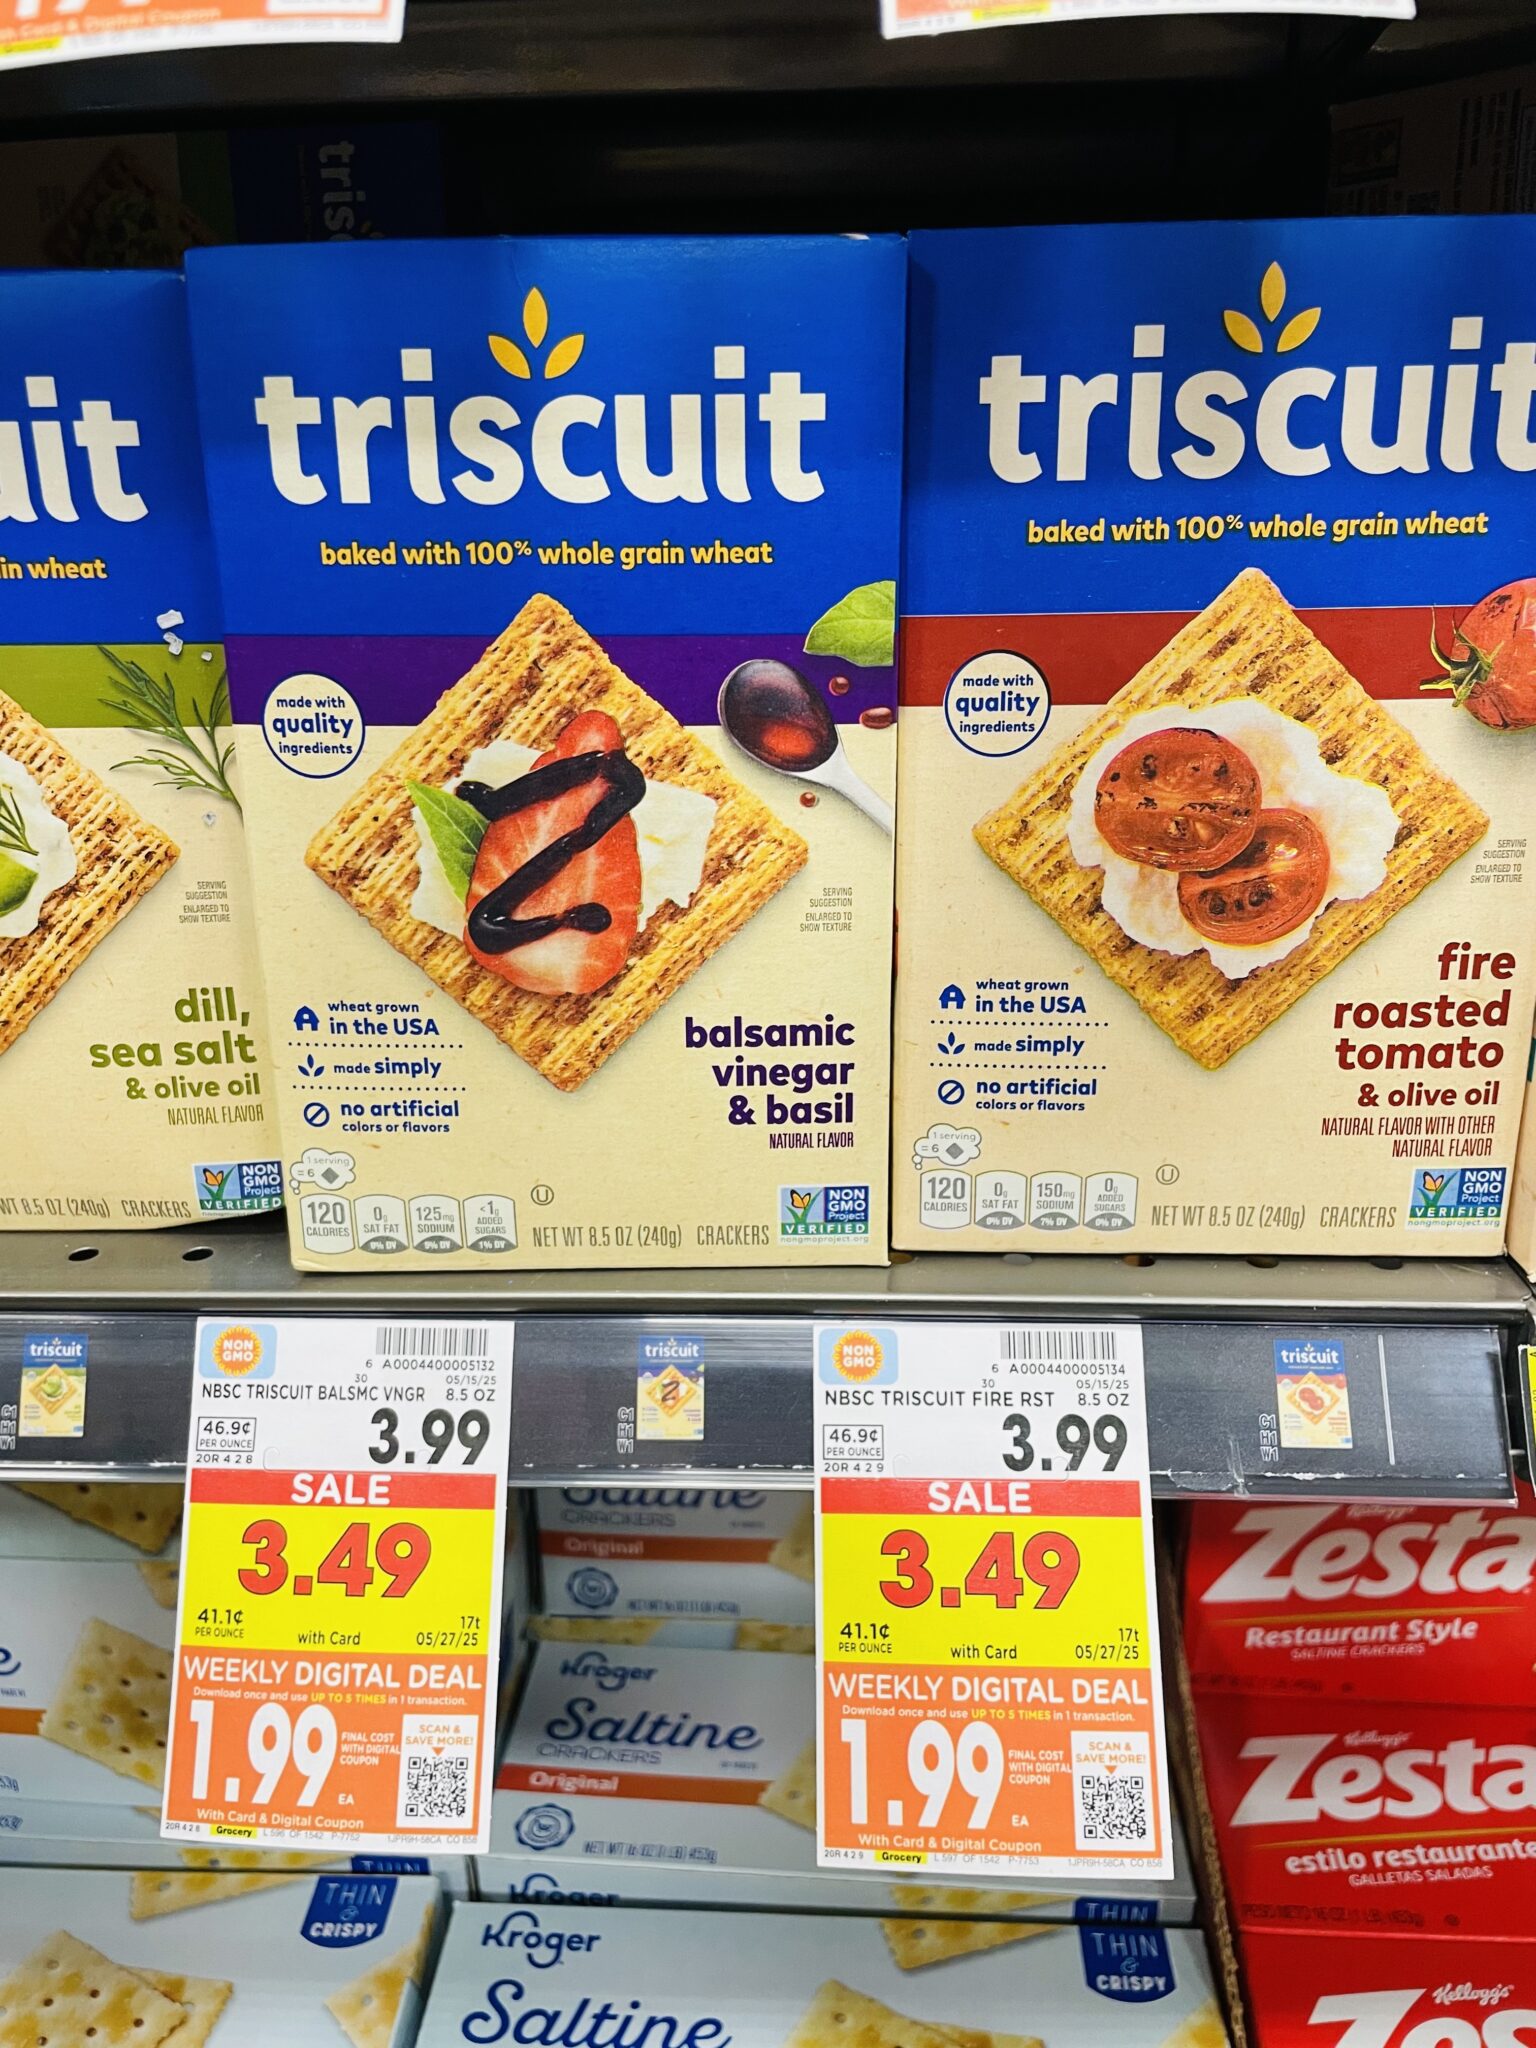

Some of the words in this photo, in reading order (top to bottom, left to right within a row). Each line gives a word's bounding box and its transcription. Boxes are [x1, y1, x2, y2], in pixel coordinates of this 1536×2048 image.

[255, 346, 826, 505] triscuit
[1027, 520, 1105, 543] baked
[1111, 518, 1169, 541] with
[1177, 514, 1243, 540] 100%
[1249, 514, 1326, 538] whole
[1332, 513, 1398, 541] grain
[1405, 512, 1489, 535] wheat
[320, 540, 396, 566] baked
[402, 541, 460, 565] with
[466, 540, 531, 565] 100%
[538, 541, 614, 565] whole
[621, 542, 684, 570] grain
[691, 540, 772, 564] wheat
[27, 557, 108, 579] wheat
[963, 675, 999, 687] made
[1003, 674, 1033, 687] with
[276, 696, 311, 709] made
[316, 696, 345, 709] with
[955, 691, 1040, 714] quality
[272, 713, 353, 738] quality
[959, 720, 1035, 735] ingredients
[278, 741, 353, 757] ingredients
[809, 898, 852, 907] SUGGESTION
[822, 888, 852, 897] SERVING
[1438, 942, 1516, 980] fire
[174, 987, 251, 1027] dill,
[328, 1001, 372, 1012] wheat
[377, 1003, 419, 1014] grown
[1334, 989, 1511, 1029] roasted
[330, 1018, 348, 1035] in
[353, 1018, 388, 1035] the
[394, 1019, 439, 1036] USA
[684, 1014, 855, 1048] balsamic
[89, 1043, 162, 1068] sea
[175, 1030, 258, 1066] salt
[1336, 1038, 1504, 1070] tomato
[333, 1063, 370, 1074] made
[375, 1057, 441, 1078] simply
[712, 1056, 854, 1093] vinegar
[126, 1078, 148, 1099] &
[155, 1076, 220, 1099] olive
[228, 1073, 261, 1096] oil
[1358, 1083, 1379, 1107] &
[1388, 1082, 1456, 1106] olive
[1465, 1081, 1499, 1106] oil
[340, 1102, 364, 1116] no
[370, 1100, 459, 1116] artificial
[728, 1095, 756, 1125] &
[767, 1092, 854, 1124] basil
[342, 1122, 381, 1132] colors
[386, 1123, 398, 1132] or
[403, 1122, 450, 1132] flavors
[1321, 1118, 1375, 1136] NATURAL
[1379, 1117, 1422, 1135] FLAVOR
[1426, 1117, 1454, 1134] WITH
[1458, 1116, 1495, 1134] OTHER
[769, 1133, 814, 1149] NATURAL
[817, 1132, 854, 1148] FLAVOR
[1392, 1139, 1444, 1157] NATURAL
[1449, 1138, 1492, 1157] FLAVOR
[1465, 1171, 1501, 1182] NON
[829, 1189, 865, 1200] NON
[1463, 1182, 1501, 1194] GMO
[24, 1199, 43, 1216] 8.5
[50, 1200, 66, 1216] OZ
[68, 1199, 111, 1219] (240g)
[121, 1200, 191, 1219] CRACKERS
[307, 1202, 345, 1224] 120
[828, 1200, 866, 1211] GMO
[1414, 1206, 1499, 1218] VERIFIED
[828, 1211, 865, 1222] Project
[306, 1226, 349, 1237] CALORIES
[417, 1224, 455, 1233] SODIUM
[533, 1227, 558, 1248] NET
[562, 1227, 583, 1247] WT
[589, 1226, 610, 1246] 8.5
[616, 1226, 632, 1246] OZ
[638, 1226, 682, 1249] (240g)
[697, 1225, 769, 1246] CRACKERS
[784, 1223, 866, 1234] VERIFIED
[29, 1342, 83, 1357] triscuit
[223, 1339, 253, 1350] NON
[645, 1342, 699, 1357] triscuit
[842, 1345, 874, 1356] NON
[223, 1351, 253, 1362] GMO
[843, 1356, 875, 1368] GMO
[1281, 1348, 1339, 1364] triscuit
[446, 1375, 497, 1385] 05/15/25
[202, 1384, 241, 1399] NBSC
[247, 1385, 313, 1400] TRISCUIT
[319, 1386, 378, 1401] BALSMC
[384, 1386, 424, 1401] VNGR
[446, 1389, 468, 1401] 8.5
[474, 1389, 496, 1402] OZ
[825, 1390, 874, 1406] NBSC
[881, 1390, 965, 1406] TRISCUIT
[973, 1392, 1013, 1407] FIRE
[1021, 1392, 1055, 1407] RST
[204, 1421, 251, 1435] 46.9¢
[368, 1407, 490, 1465] 3.99
[829, 1428, 878, 1443] 46.9¢
[1002, 1413, 1127, 1472] 3.99
[291, 1473, 392, 1505] SALE
[928, 1482, 1031, 1513] SALE
[563, 1537, 644, 1556] Original
[1200, 1504, 1536, 1604] Zesta
[238, 1518, 432, 1598] 3.49
[879, 1529, 1080, 1609] 3.49
[198, 1608, 243, 1625] 41.1¢
[298, 1632, 325, 1645] with
[330, 1631, 361, 1646] Card
[416, 1632, 478, 1648] 05/27/25
[840, 1622, 890, 1640] 41.1¢
[1245, 1625, 1399, 1649] Restaurant
[1406, 1617, 1479, 1646] Style
[1075, 1644, 1139, 1661] 05/27/25
[183, 1657, 290, 1685] WEEKLY
[294, 1661, 400, 1688] DIGITAL
[408, 1664, 482, 1690] DEAL
[560, 1651, 657, 1691] Kroger
[828, 1672, 944, 1700] WEEKLY
[953, 1676, 1064, 1704] DIGITAL
[1072, 1678, 1148, 1706] DEAL
[546, 1696, 764, 1751] Saltine
[190, 1699, 338, 1807] 1.99
[1089, 1741, 1122, 1751] SCAN
[1125, 1741, 1132, 1751] &
[1076, 1753, 1106, 1764] SAVE
[1109, 1753, 1146, 1764] MORE!
[529, 1771, 620, 1793] Original
[841, 1718, 1004, 1830] 1.99
[1229, 1732, 1536, 1827] Zesta
[216, 1826, 253, 1838] Grocery
[881, 1852, 922, 1863] Grocery
[1285, 1848, 1367, 1874] estilo
[1349, 1870, 1423, 1887] GALLETAS
[1426, 1866, 1494, 1881] SALADAS
[325, 1882, 387, 1905] THIN
[310, 1922, 379, 1938] CRISPY
[481, 1911, 601, 1969] Kroger
[1091, 1932, 1158, 1957] THIN
[1096, 1975, 1166, 1991] CRISPY
[461, 1979, 733, 2048] Saltine
